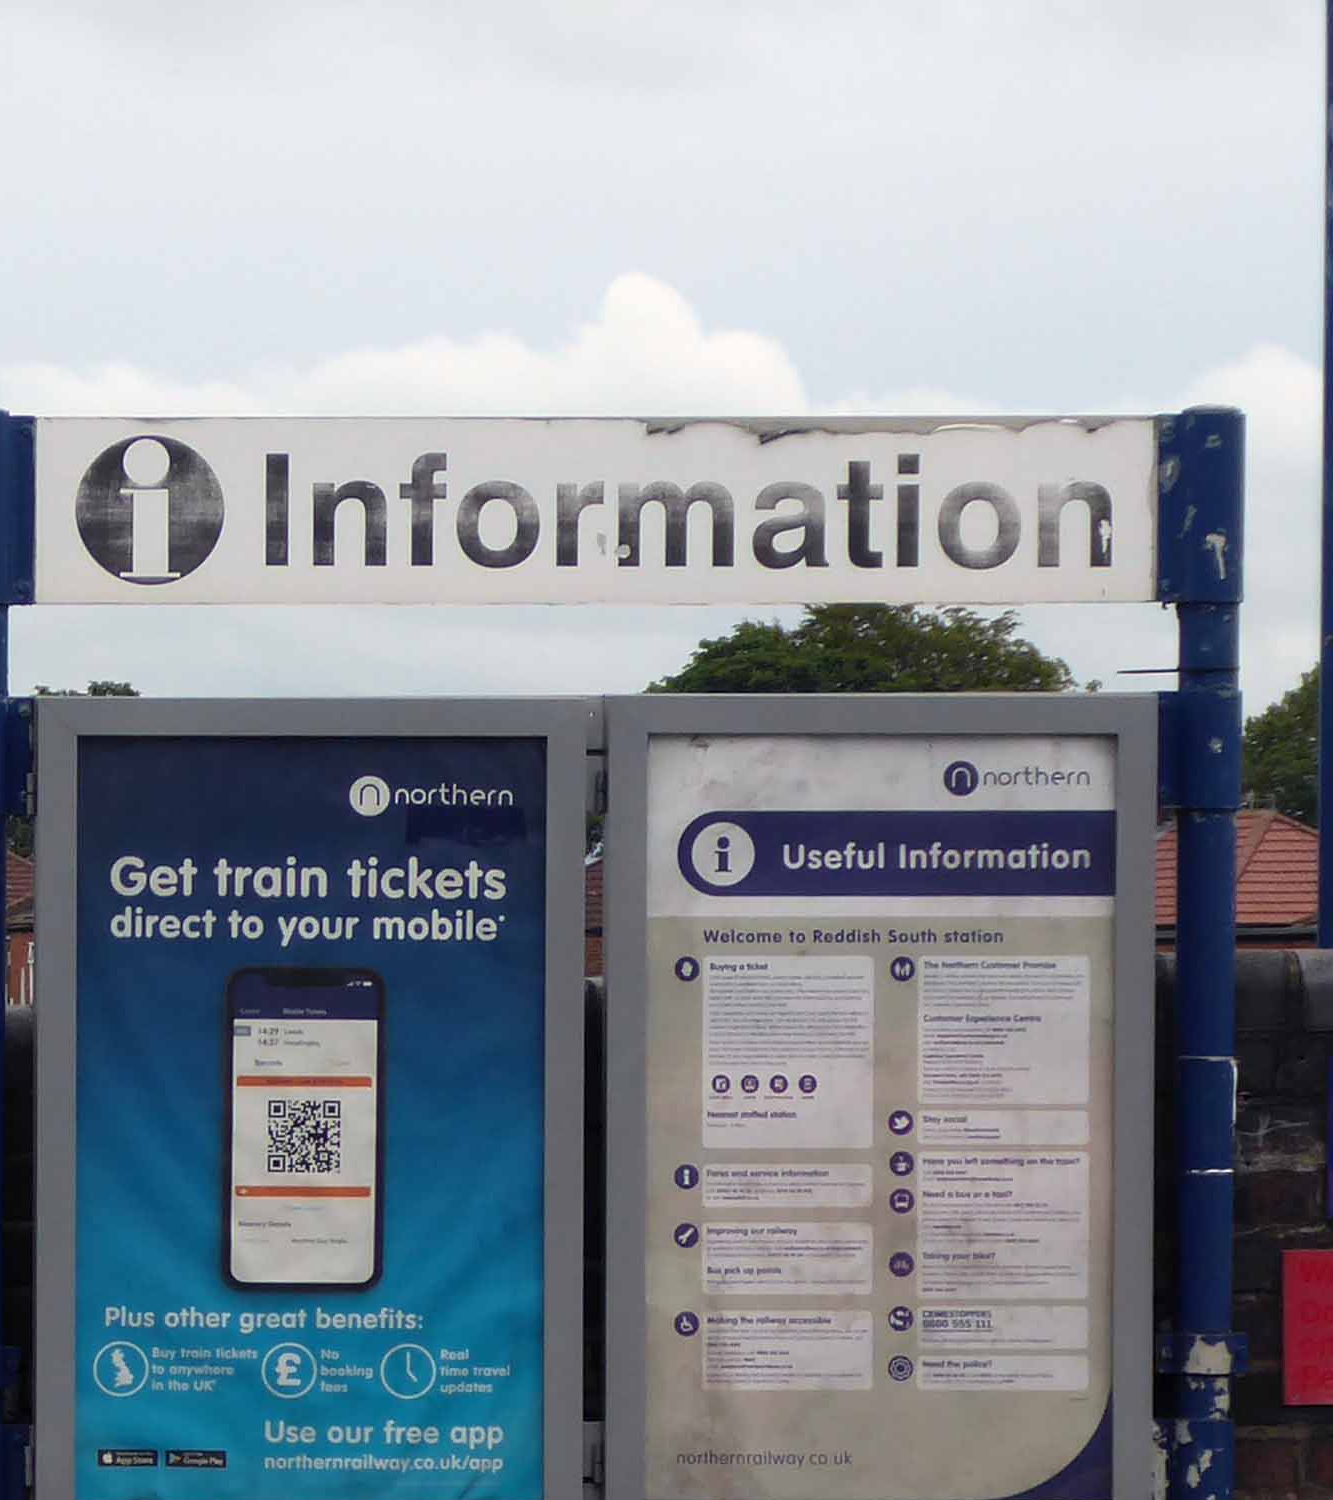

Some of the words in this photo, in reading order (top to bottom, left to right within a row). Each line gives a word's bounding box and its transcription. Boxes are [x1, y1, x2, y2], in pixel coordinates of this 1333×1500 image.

[265, 442, 1113, 571] Information
[982, 766, 1091, 787] northern
[393, 782, 514, 806] northern
[782, 841, 885, 870] Useful
[898, 841, 1090, 870] Information
[110, 855, 198, 897] Get
[212, 856, 328, 898] train
[346, 855, 507, 900] tickets
[110, 905, 217, 939] direct
[227, 909, 264, 940] to
[277, 915, 360, 948] your
[703, 928, 783, 944] Welcome
[788, 930, 806, 944] to
[812, 928, 881, 944] Reddish
[887, 928, 938, 944] South
[943, 929, 1004, 944] station
[104, 1305, 155, 1328] Plus
[164, 1305, 232, 1329] other
[238, 1308, 308, 1335] great
[315, 1306, 423, 1330] benefits:
[151, 1346, 177, 1361] Buy
[180, 1348, 212, 1359] train
[215, 1346, 259, 1360] tickets
[264, 1419, 317, 1444] Use
[326, 1425, 374, 1444] our
[382, 1419, 440, 1445] free
[449, 1425, 504, 1451] app
[264, 1453, 504, 1474] northernrailway.co.uk/app
